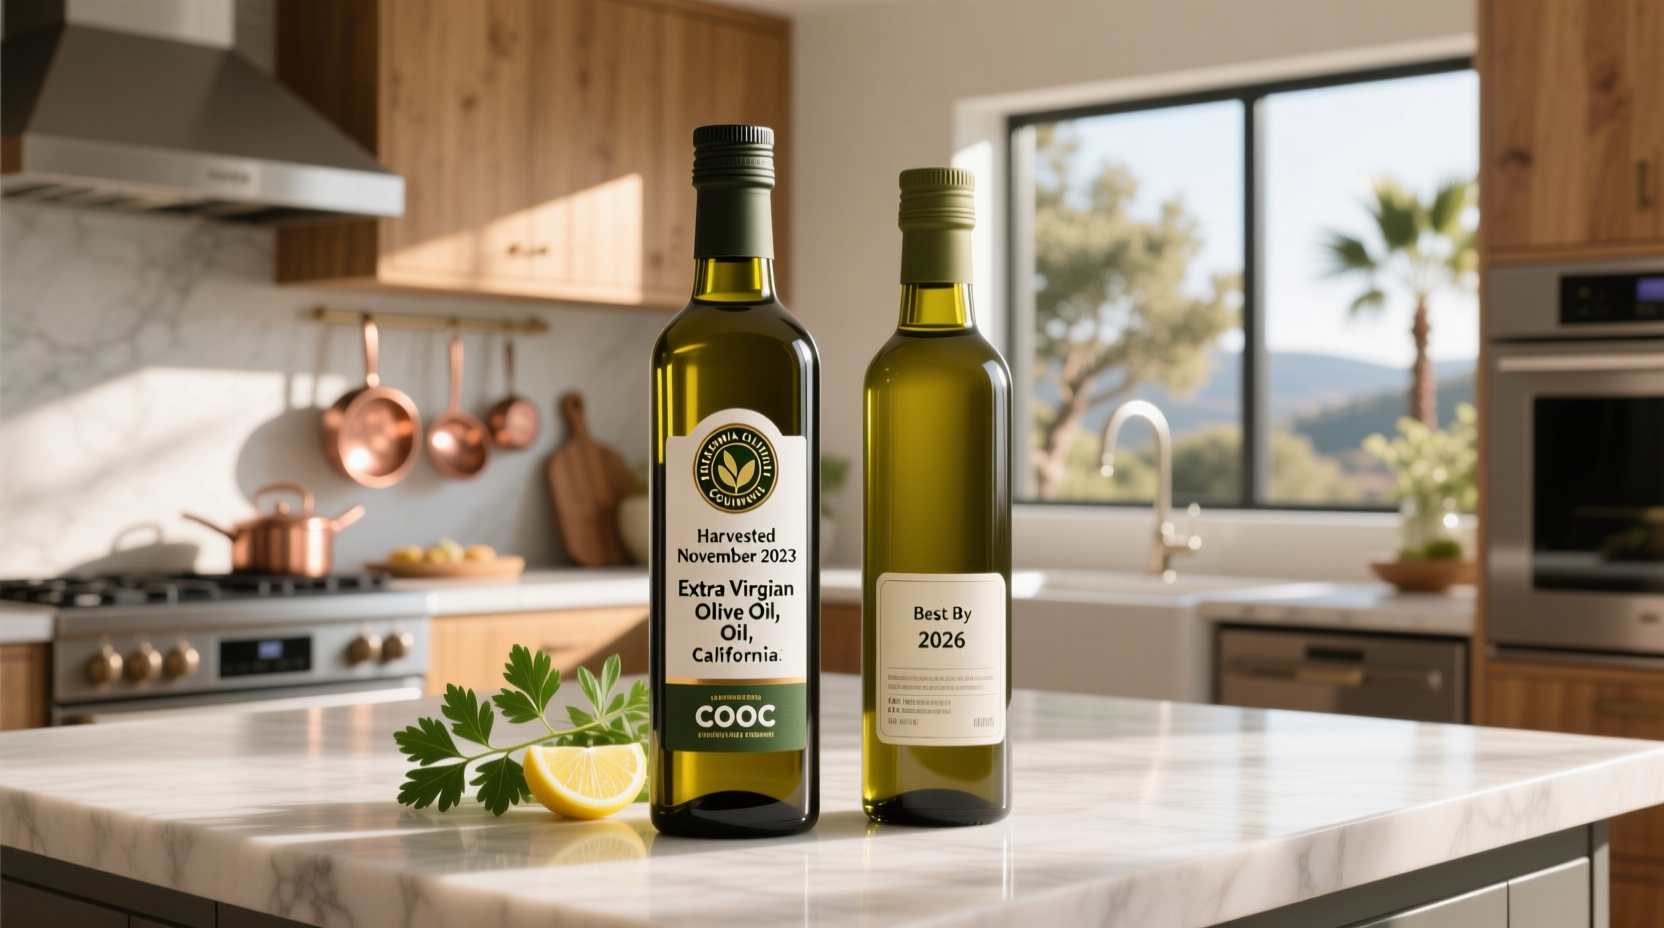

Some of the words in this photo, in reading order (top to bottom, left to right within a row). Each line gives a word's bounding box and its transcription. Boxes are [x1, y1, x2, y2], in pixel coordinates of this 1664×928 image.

[697, 528, 776, 543] Harvested
[677, 547, 757, 563] November
[761, 548, 797, 563] 2023
[678, 579, 725, 598] Extra
[729, 579, 794, 601] Virgian
[694, 602, 744, 620] Olive
[748, 602, 780, 624] Oil,
[914, 606, 948, 621] Best
[952, 606, 972, 624] By
[720, 624, 753, 644] Oil,
[918, 631, 966, 648] 2026
[695, 704, 776, 728] COOC
